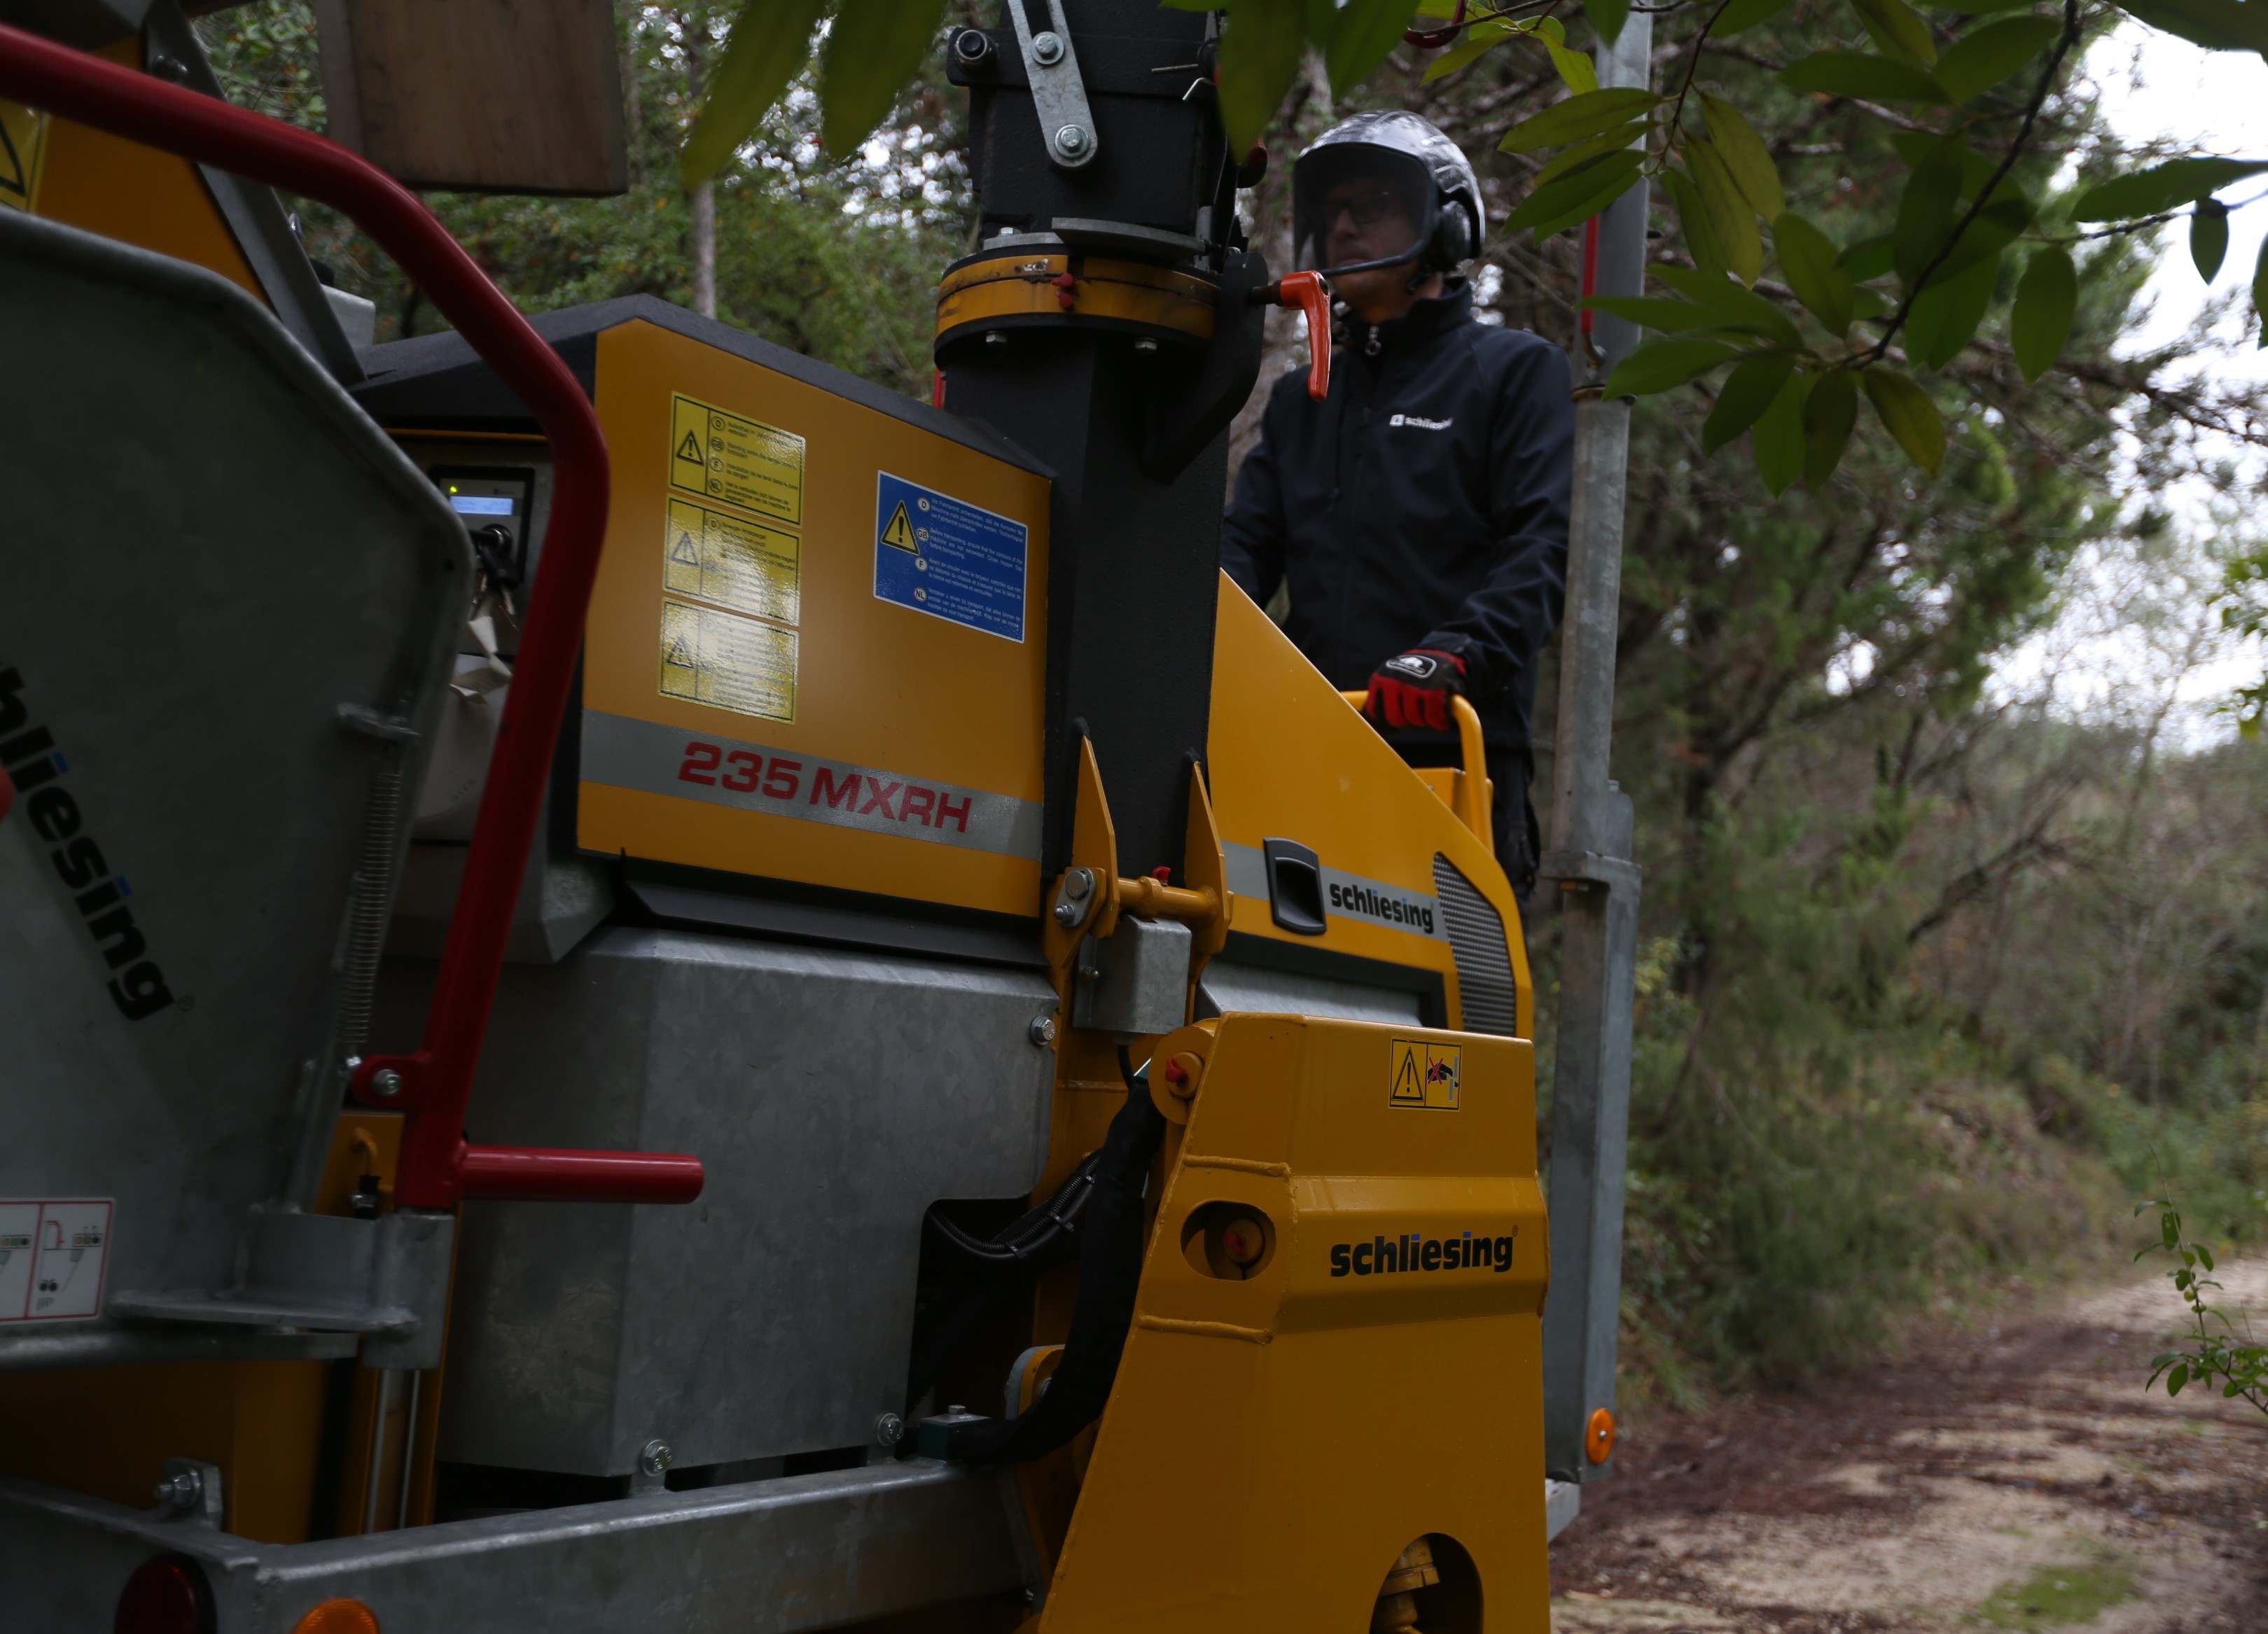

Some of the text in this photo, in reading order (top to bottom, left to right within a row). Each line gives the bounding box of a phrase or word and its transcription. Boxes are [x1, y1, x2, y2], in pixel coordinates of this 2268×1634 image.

[917, 530, 927, 539] GB
[916, 590, 924, 599] NL
[678, 741, 972, 833] 235 MXRH
[0, 662, 175, 1021] hliesing
[1329, 883, 1435, 935] schliesing
[1330, 1231, 1514, 1277] schliesing
